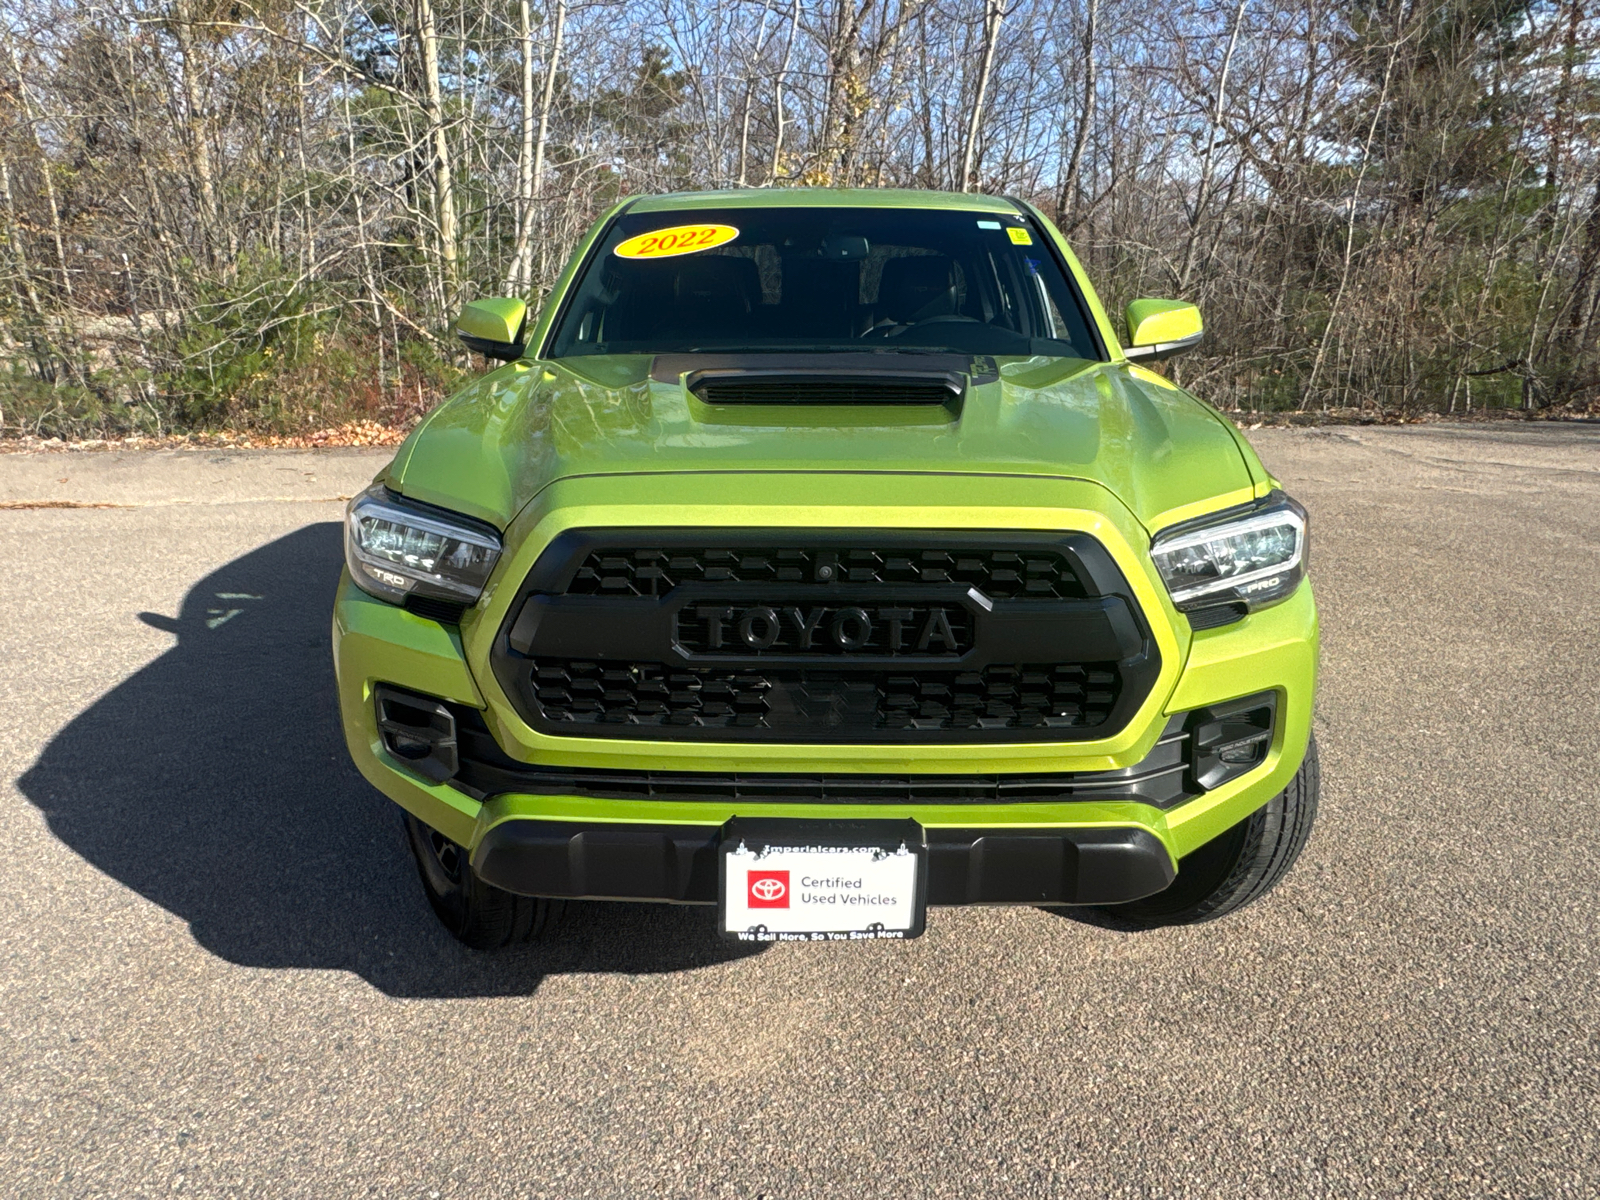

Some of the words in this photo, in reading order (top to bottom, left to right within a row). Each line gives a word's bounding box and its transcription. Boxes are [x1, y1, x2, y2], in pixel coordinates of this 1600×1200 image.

[636, 229, 717, 254] 2022
[373, 568, 405, 585] TRD
[1247, 577, 1280, 593] PRO
[696, 605, 958, 650] TOYOTA
[764, 845, 881, 854] Imperialcars.com
[801, 876, 862, 889] Certified
[801, 893, 836, 905] Used
[840, 893, 897, 905] Vehicles
[738, 932, 755, 941] We
[757, 932, 776, 941] Sell
[779, 932, 809, 942] More,
[811, 932, 825, 941] So
[827, 931, 847, 940] You
[850, 930, 875, 940] Save
[877, 930, 904, 939] More
